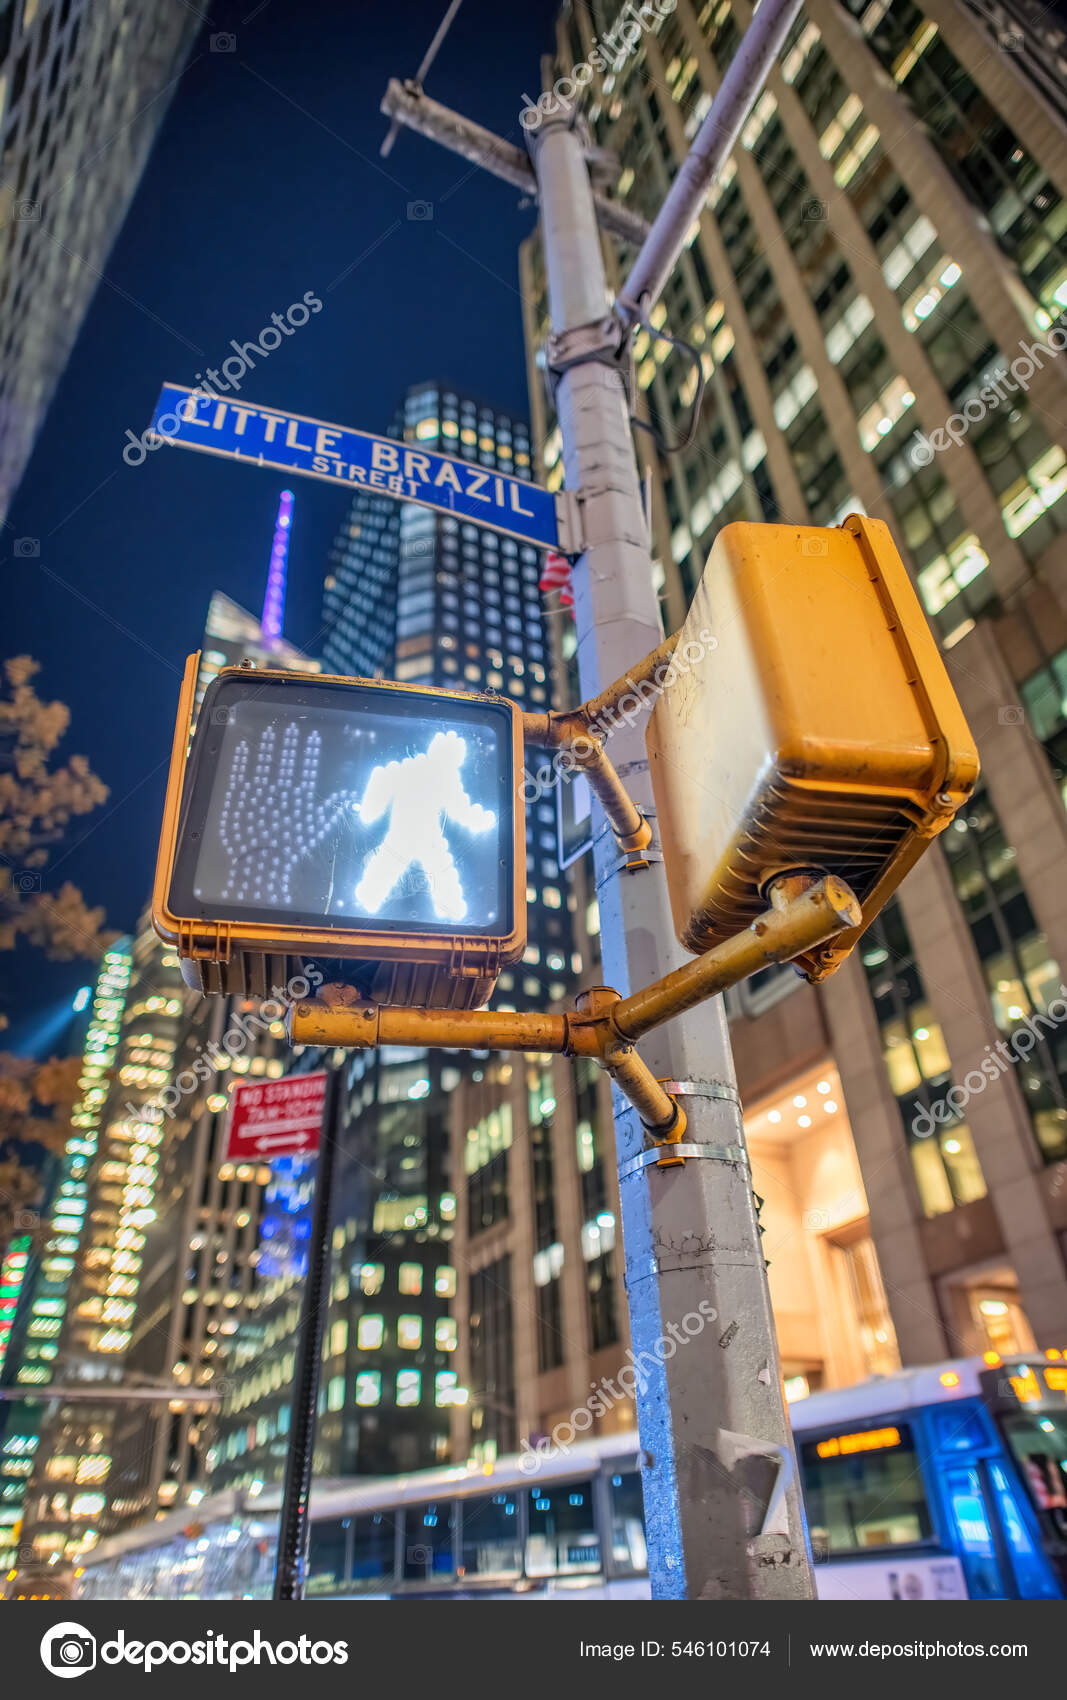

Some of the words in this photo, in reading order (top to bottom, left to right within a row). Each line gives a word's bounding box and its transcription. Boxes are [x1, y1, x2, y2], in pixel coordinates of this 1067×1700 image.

[182, 396, 342, 458] LITTLE
[371, 442, 536, 518] BRAZIL
[311, 455, 422, 498] STREET
[239, 1088, 263, 1107] NO
[263, 1079, 326, 1104] STANDIN
